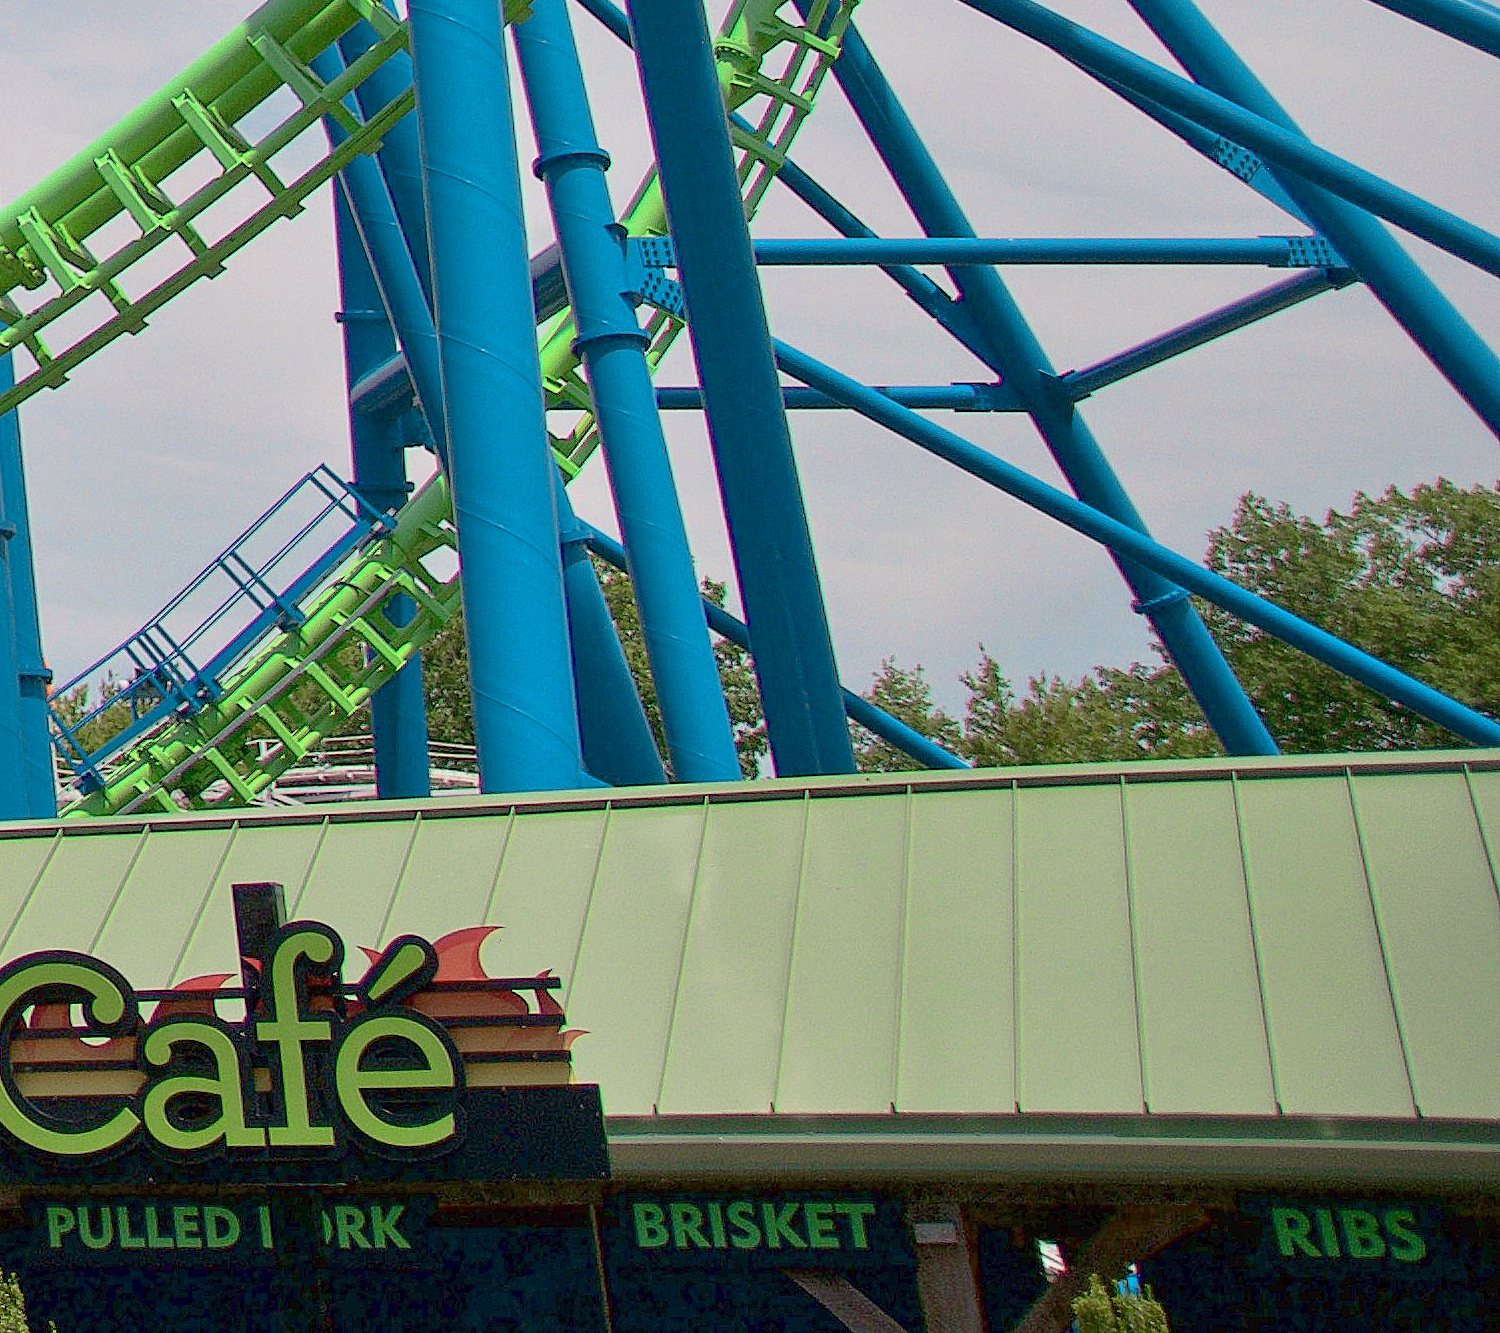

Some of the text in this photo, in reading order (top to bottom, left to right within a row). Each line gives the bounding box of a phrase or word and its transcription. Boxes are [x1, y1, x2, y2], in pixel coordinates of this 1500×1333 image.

[46, 1205, 411, 1250] PULLED RK
[632, 1200, 877, 1249] BRISKET
[1273, 1207, 1428, 1263] RIBS
